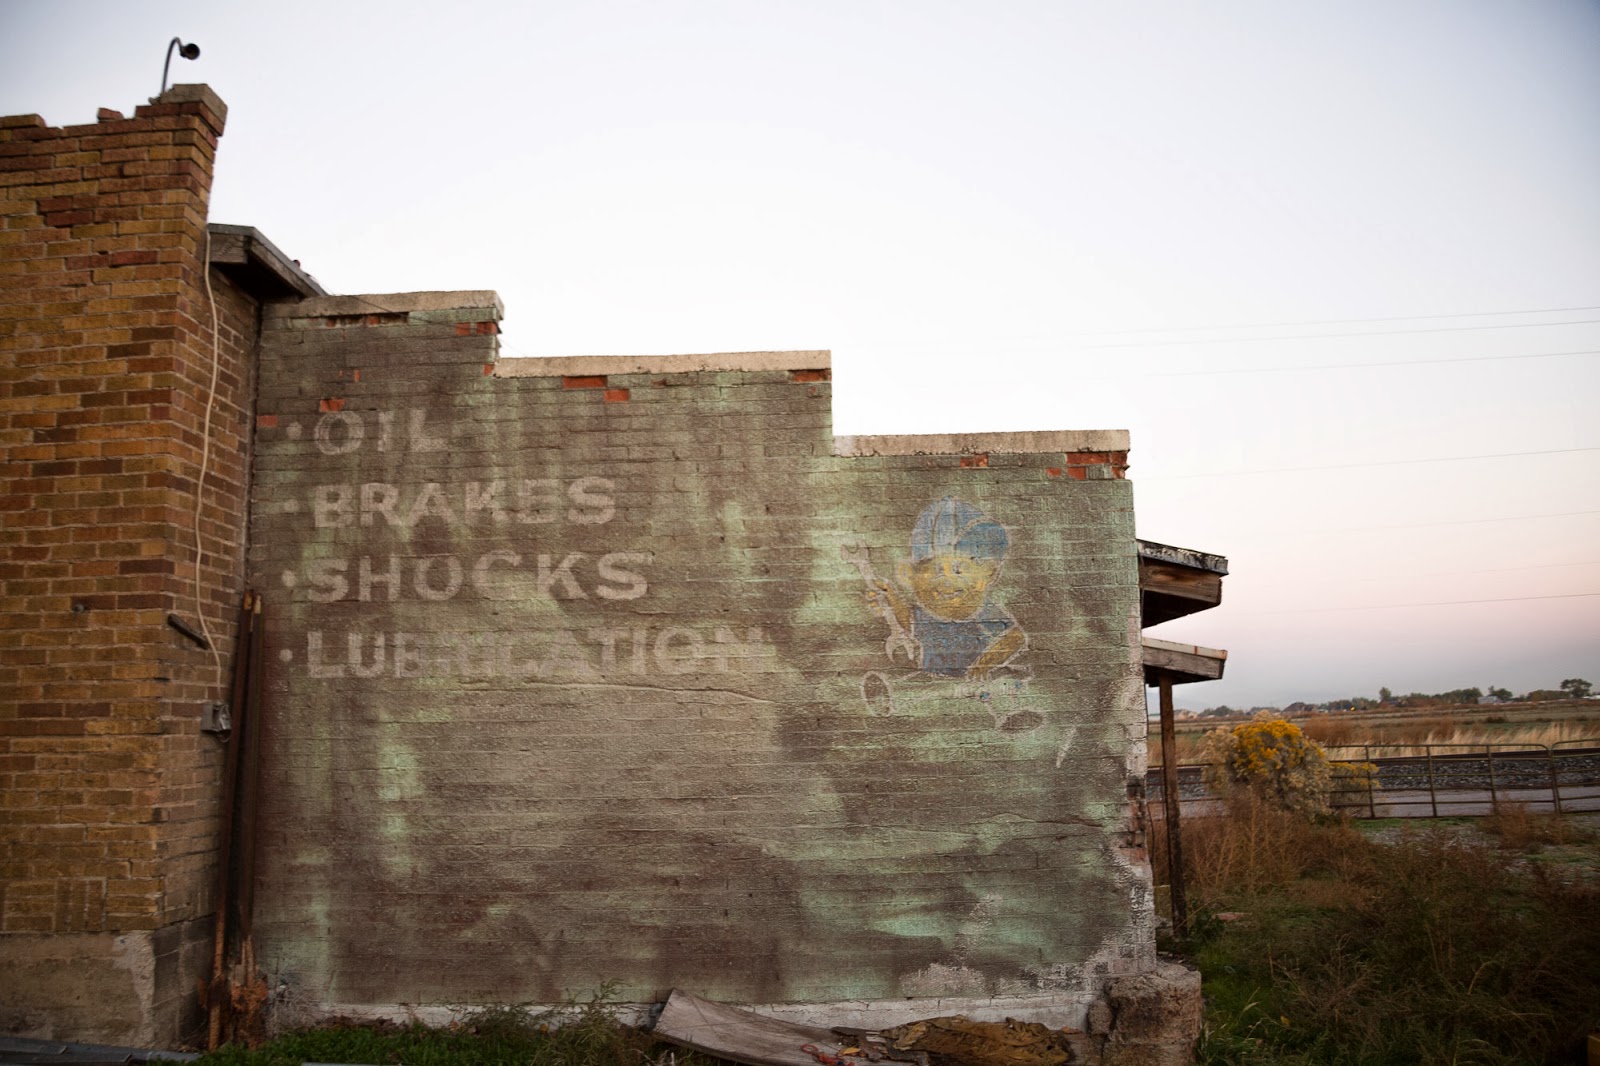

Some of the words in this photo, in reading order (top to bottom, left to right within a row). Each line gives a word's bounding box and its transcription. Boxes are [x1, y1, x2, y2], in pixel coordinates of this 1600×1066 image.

[314, 408, 449, 455] OIL
[314, 476, 616, 527] BRAKES
[308, 550, 654, 602] SHOCKS
